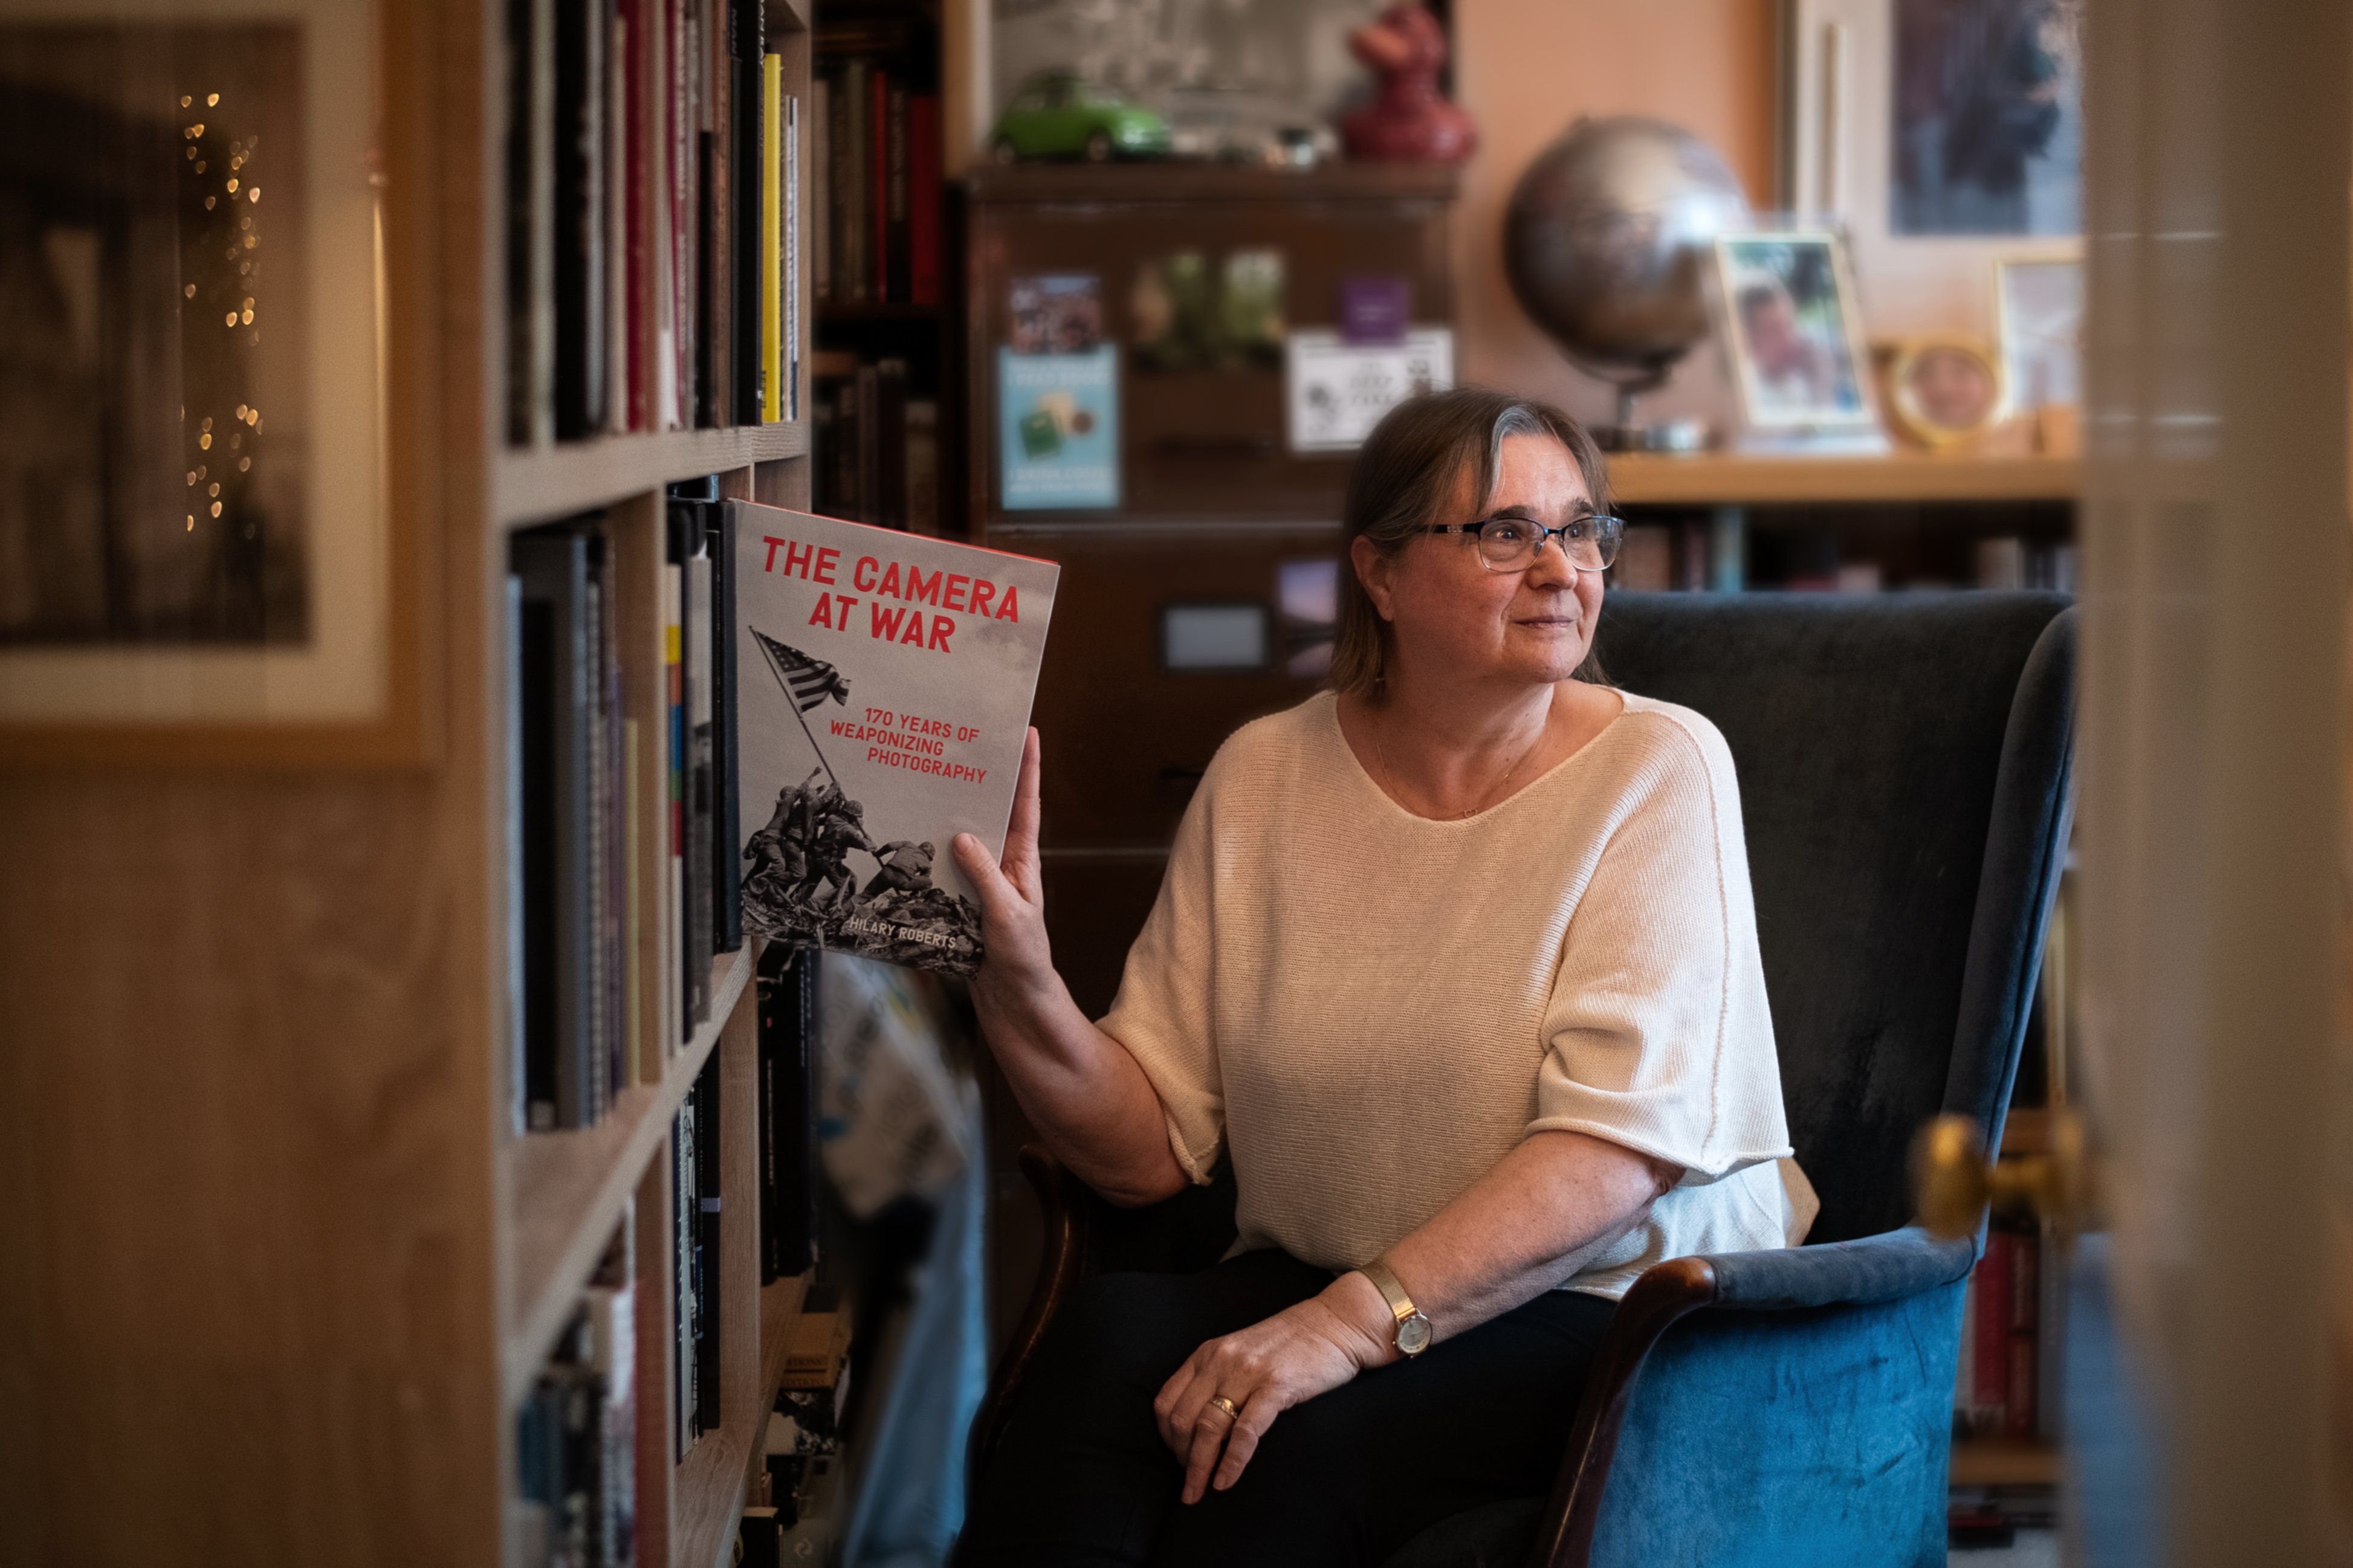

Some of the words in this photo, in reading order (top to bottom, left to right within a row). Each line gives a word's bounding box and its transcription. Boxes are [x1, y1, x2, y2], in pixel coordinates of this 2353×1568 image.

[763, 535, 841, 586] THE
[853, 555, 1019, 624] CAMERA
[808, 591, 859, 632] AT
[871, 601, 956, 654] WAR
[830, 720, 944, 757] WEAPONIZING
[864, 707, 894, 728] 170
[900, 715, 952, 739] YEARS
[957, 726, 980, 744] OF
[867, 747, 987, 784] PHOTOGRAPHY
[849, 916, 896, 936] HILARY
[899, 926, 957, 949] ROBERTS
